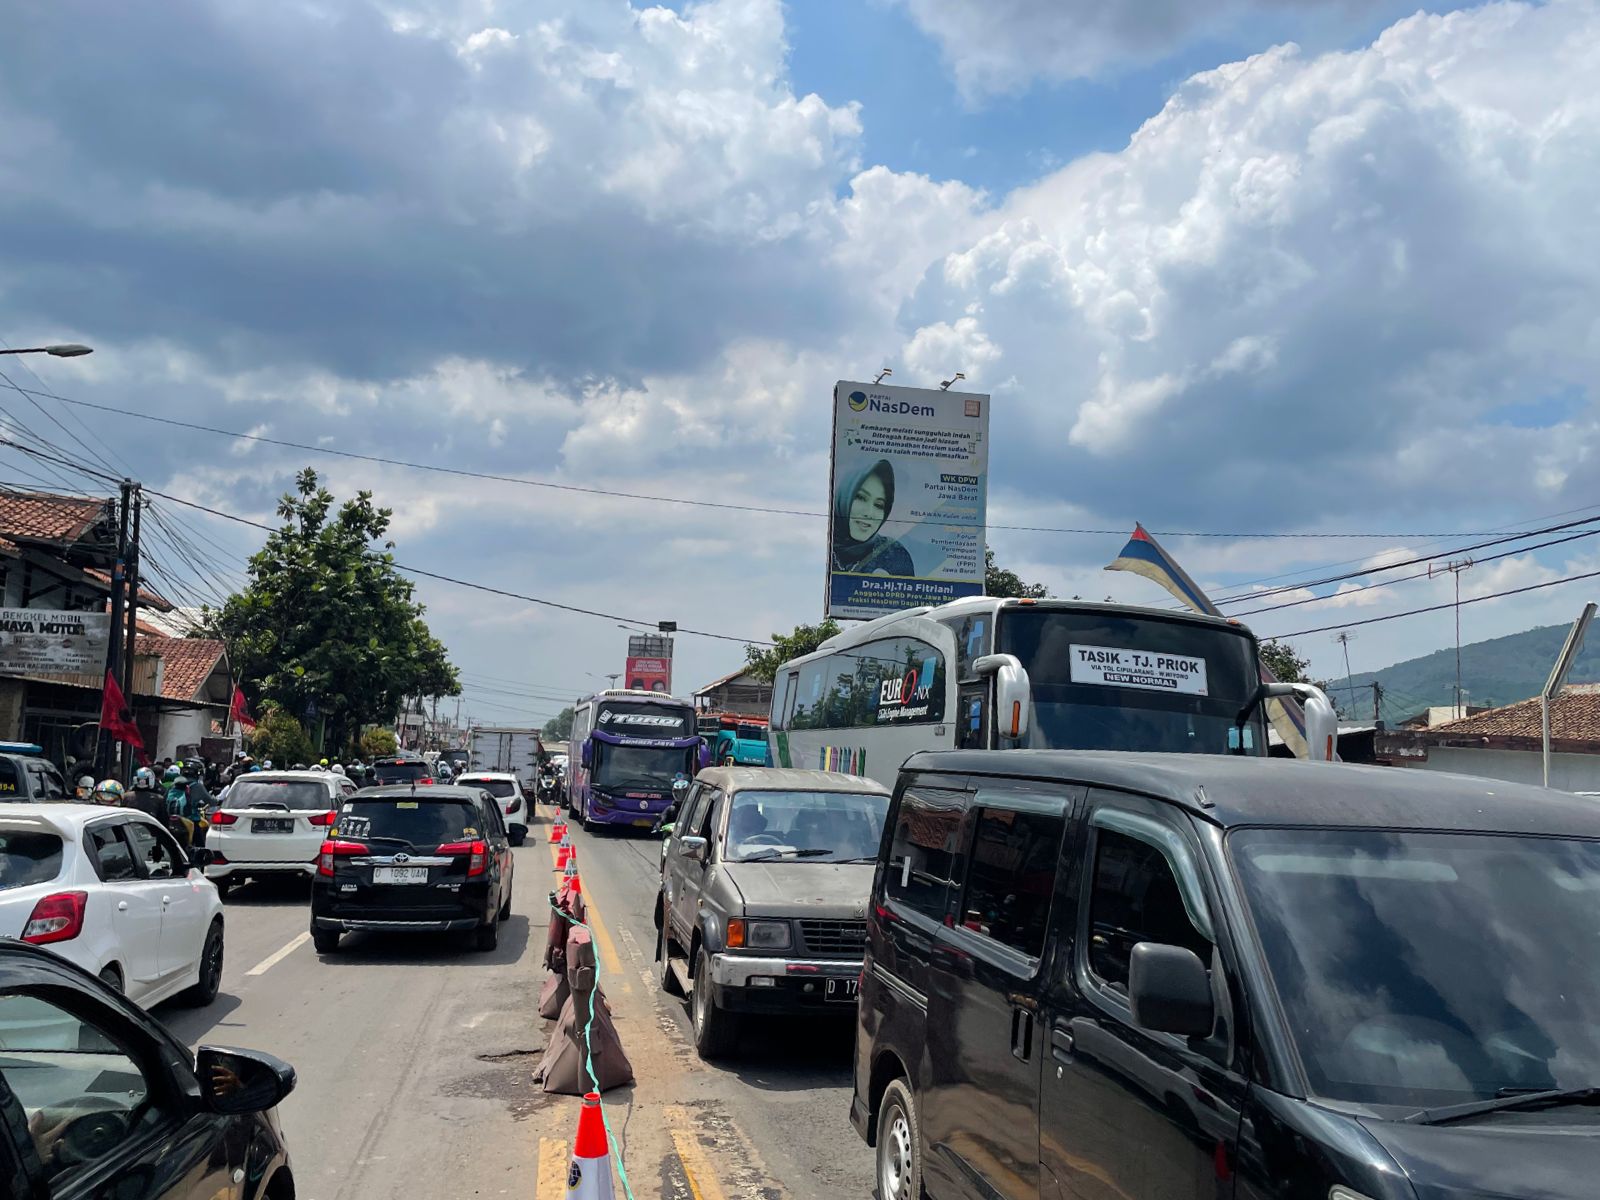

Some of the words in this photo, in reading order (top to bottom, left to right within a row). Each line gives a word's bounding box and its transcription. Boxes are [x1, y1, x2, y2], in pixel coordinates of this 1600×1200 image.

[869, 399, 935, 417] NasDem
[861, 424, 891, 433] Kembang
[914, 429, 952, 439] sungguhlah
[872, 432, 902, 441] Ditengah
[886, 441, 920, 449] Ramadhan
[935, 452, 969, 460] dimaafkan
[958, 476, 977, 484] DPW
[925, 483, 946, 491] Partai
[948, 484, 978, 493] NasDem
[915, 583, 954, 594] Fitriani
[3, 611, 48, 621] BENGKEL
[51, 615, 82, 623] MOBIL
[39, 623, 85, 636] MOTOR
[1078, 650, 1120, 664] TASIK
[1132, 655, 1153, 668] TJ.
[1157, 658, 1199, 673] PRIOK
[1106, 674, 1130, 682] NEW
[1132, 676, 1176, 688] NORMAL
[828, 980, 835, 994] D
